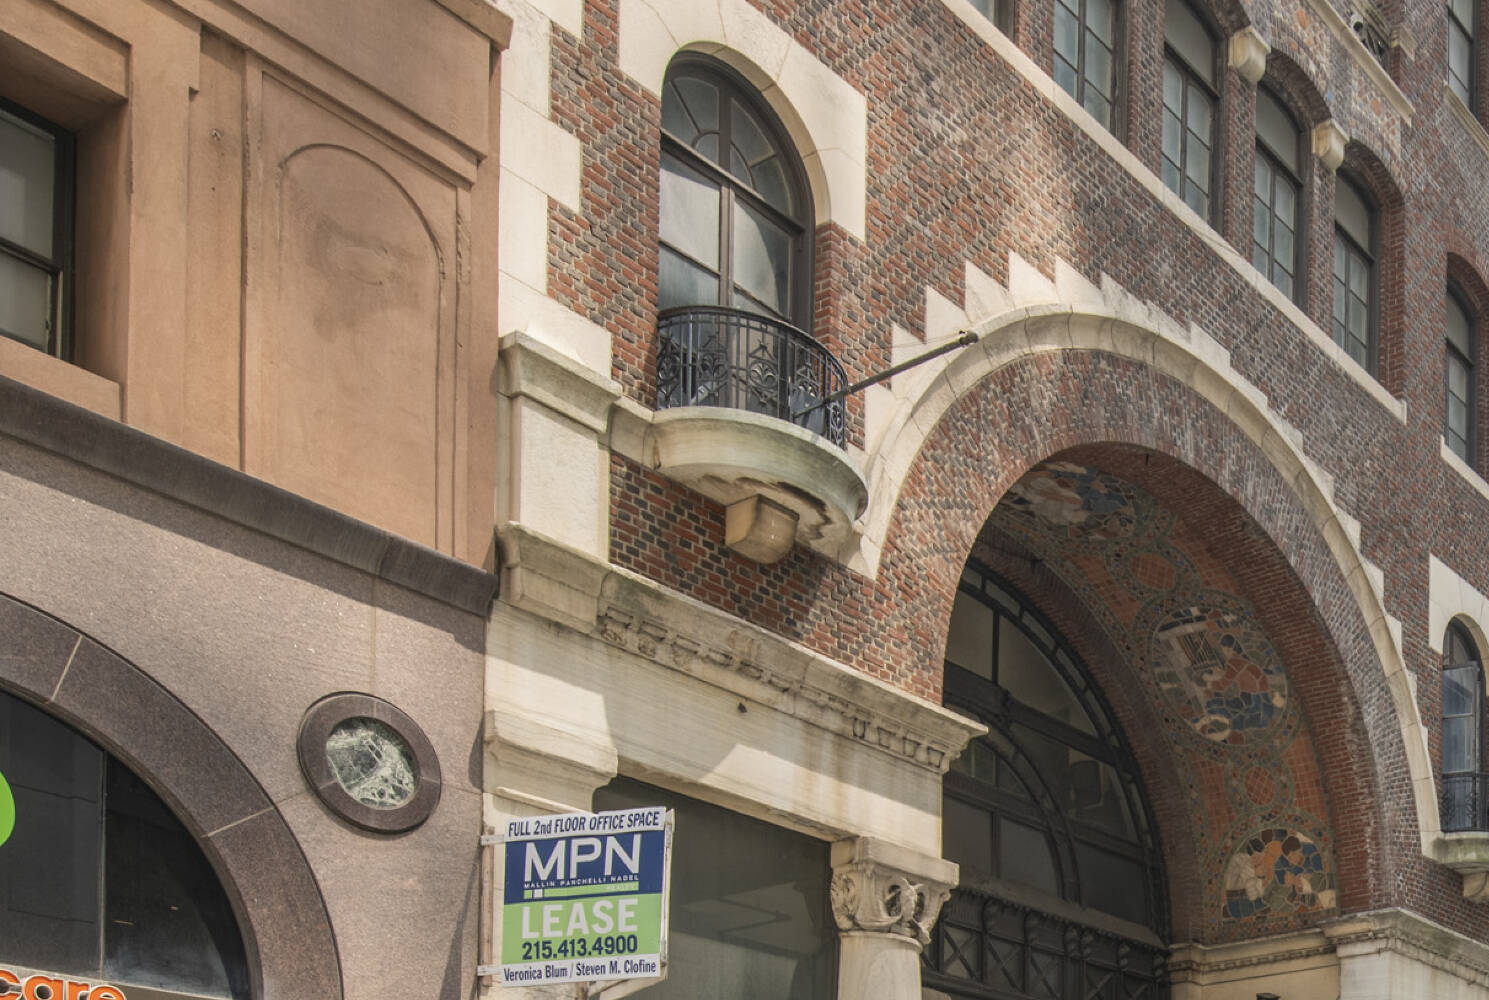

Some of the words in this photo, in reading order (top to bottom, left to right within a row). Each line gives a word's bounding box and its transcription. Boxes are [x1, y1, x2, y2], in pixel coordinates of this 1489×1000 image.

[509, 820, 531, 837] FULL
[534, 819, 551, 835] 2nd
[554, 816, 586, 833] FLOOR
[589, 814, 624, 831] OFFICE
[627, 811, 660, 828] SPACE
[524, 833, 642, 882] MPN
[524, 880, 556, 889] MALLIN
[522, 898, 638, 939] LEASE
[522, 934, 638, 960] 215.413.4900
[504, 967, 543, 982] Veronica
[545, 965, 568, 978] Blum
[576, 962, 606, 976] Steven
[609, 962, 621, 974] M.
[624, 959, 656, 973] Clofine
